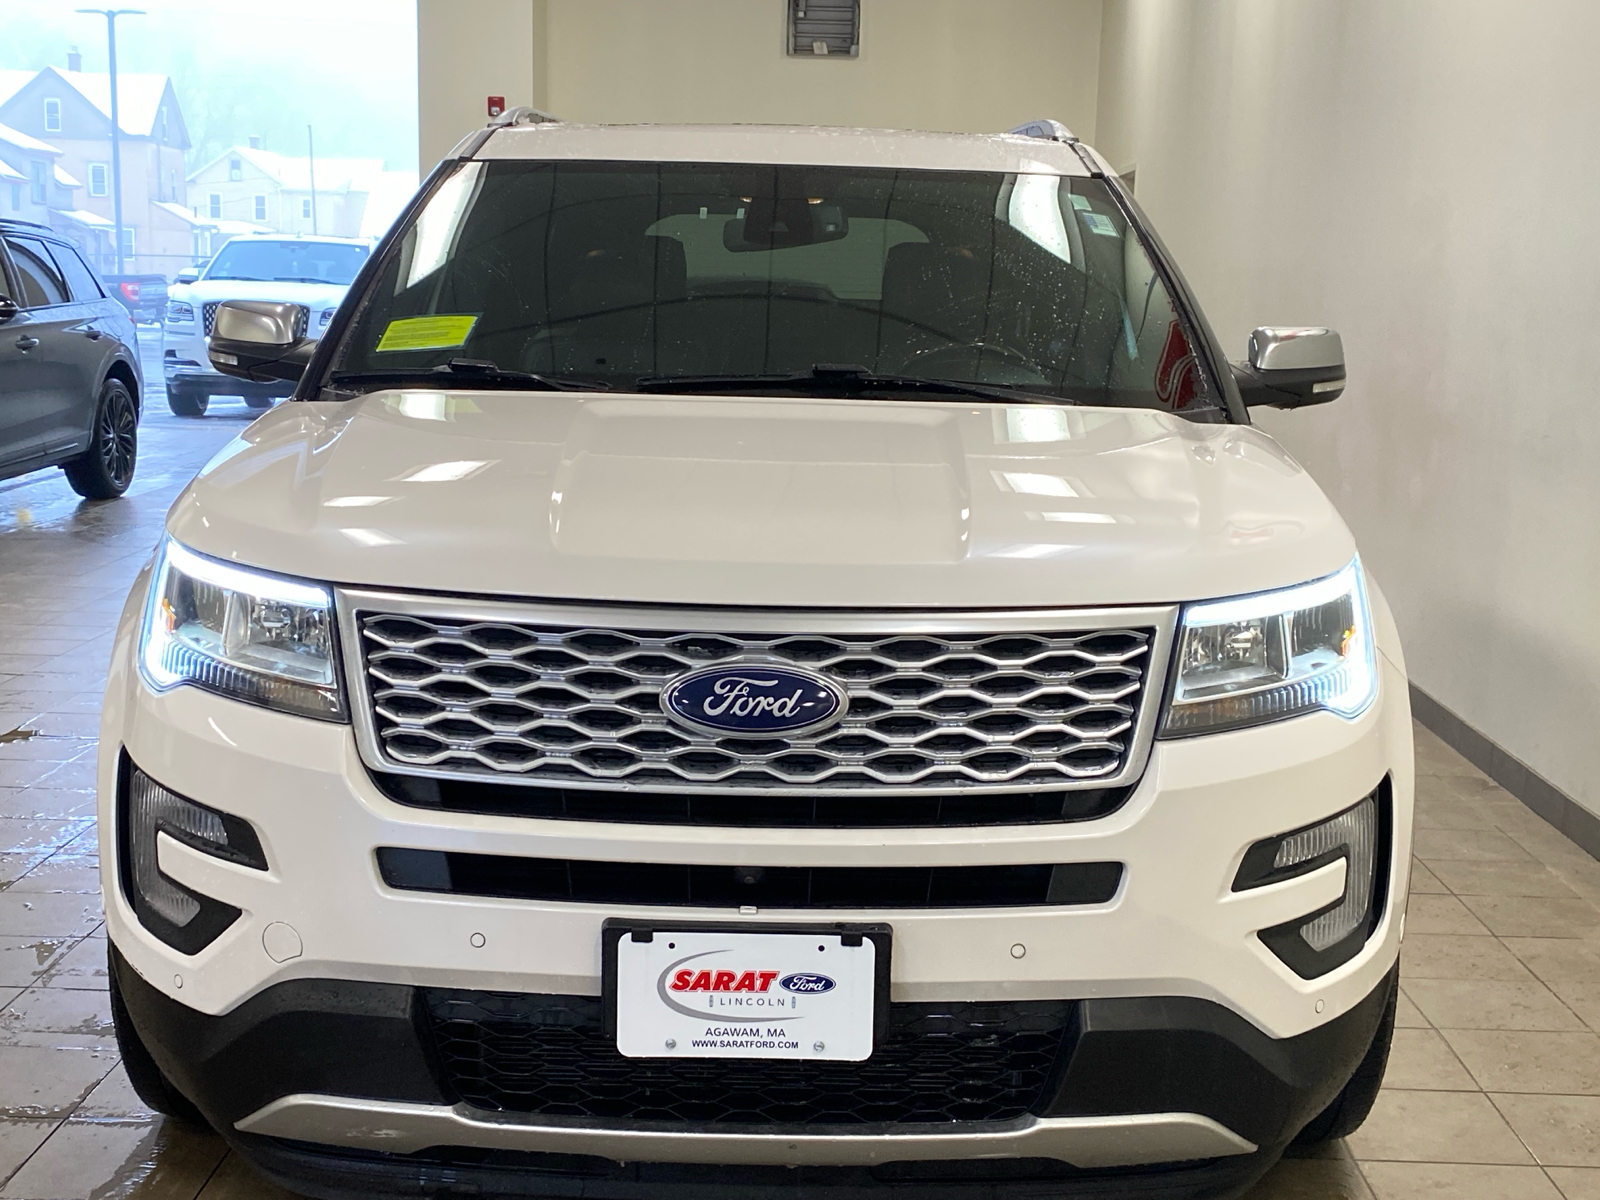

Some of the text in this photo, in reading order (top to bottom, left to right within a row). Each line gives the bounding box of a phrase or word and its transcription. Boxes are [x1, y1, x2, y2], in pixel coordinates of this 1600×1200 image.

[703, 676, 803, 717] Ford
[670, 969, 825, 993] SARAT Ford
[719, 997, 785, 1007] LINCOLN
[705, 1027, 786, 1038] AGAWAM, MA
[691, 1040, 799, 1050] WWW.SARATFORD.COM
